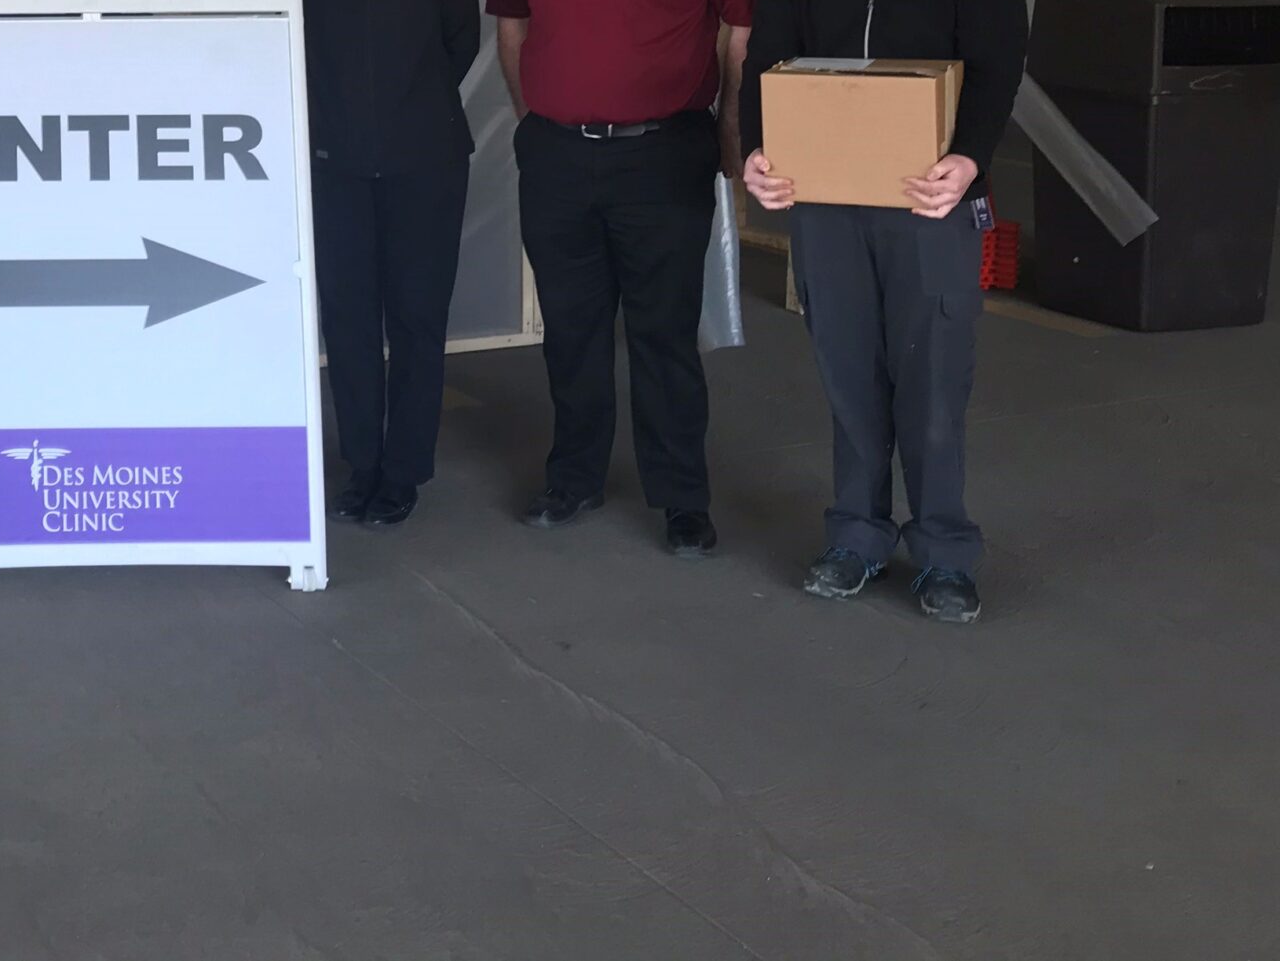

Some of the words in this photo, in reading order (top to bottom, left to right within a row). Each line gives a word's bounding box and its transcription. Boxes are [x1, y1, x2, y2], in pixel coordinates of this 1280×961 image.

[42, 465, 85, 486] DES
[92, 464, 184, 486] MOINES
[43, 488, 180, 510] UNIVERSITY
[42, 511, 125, 532] CLINIC
